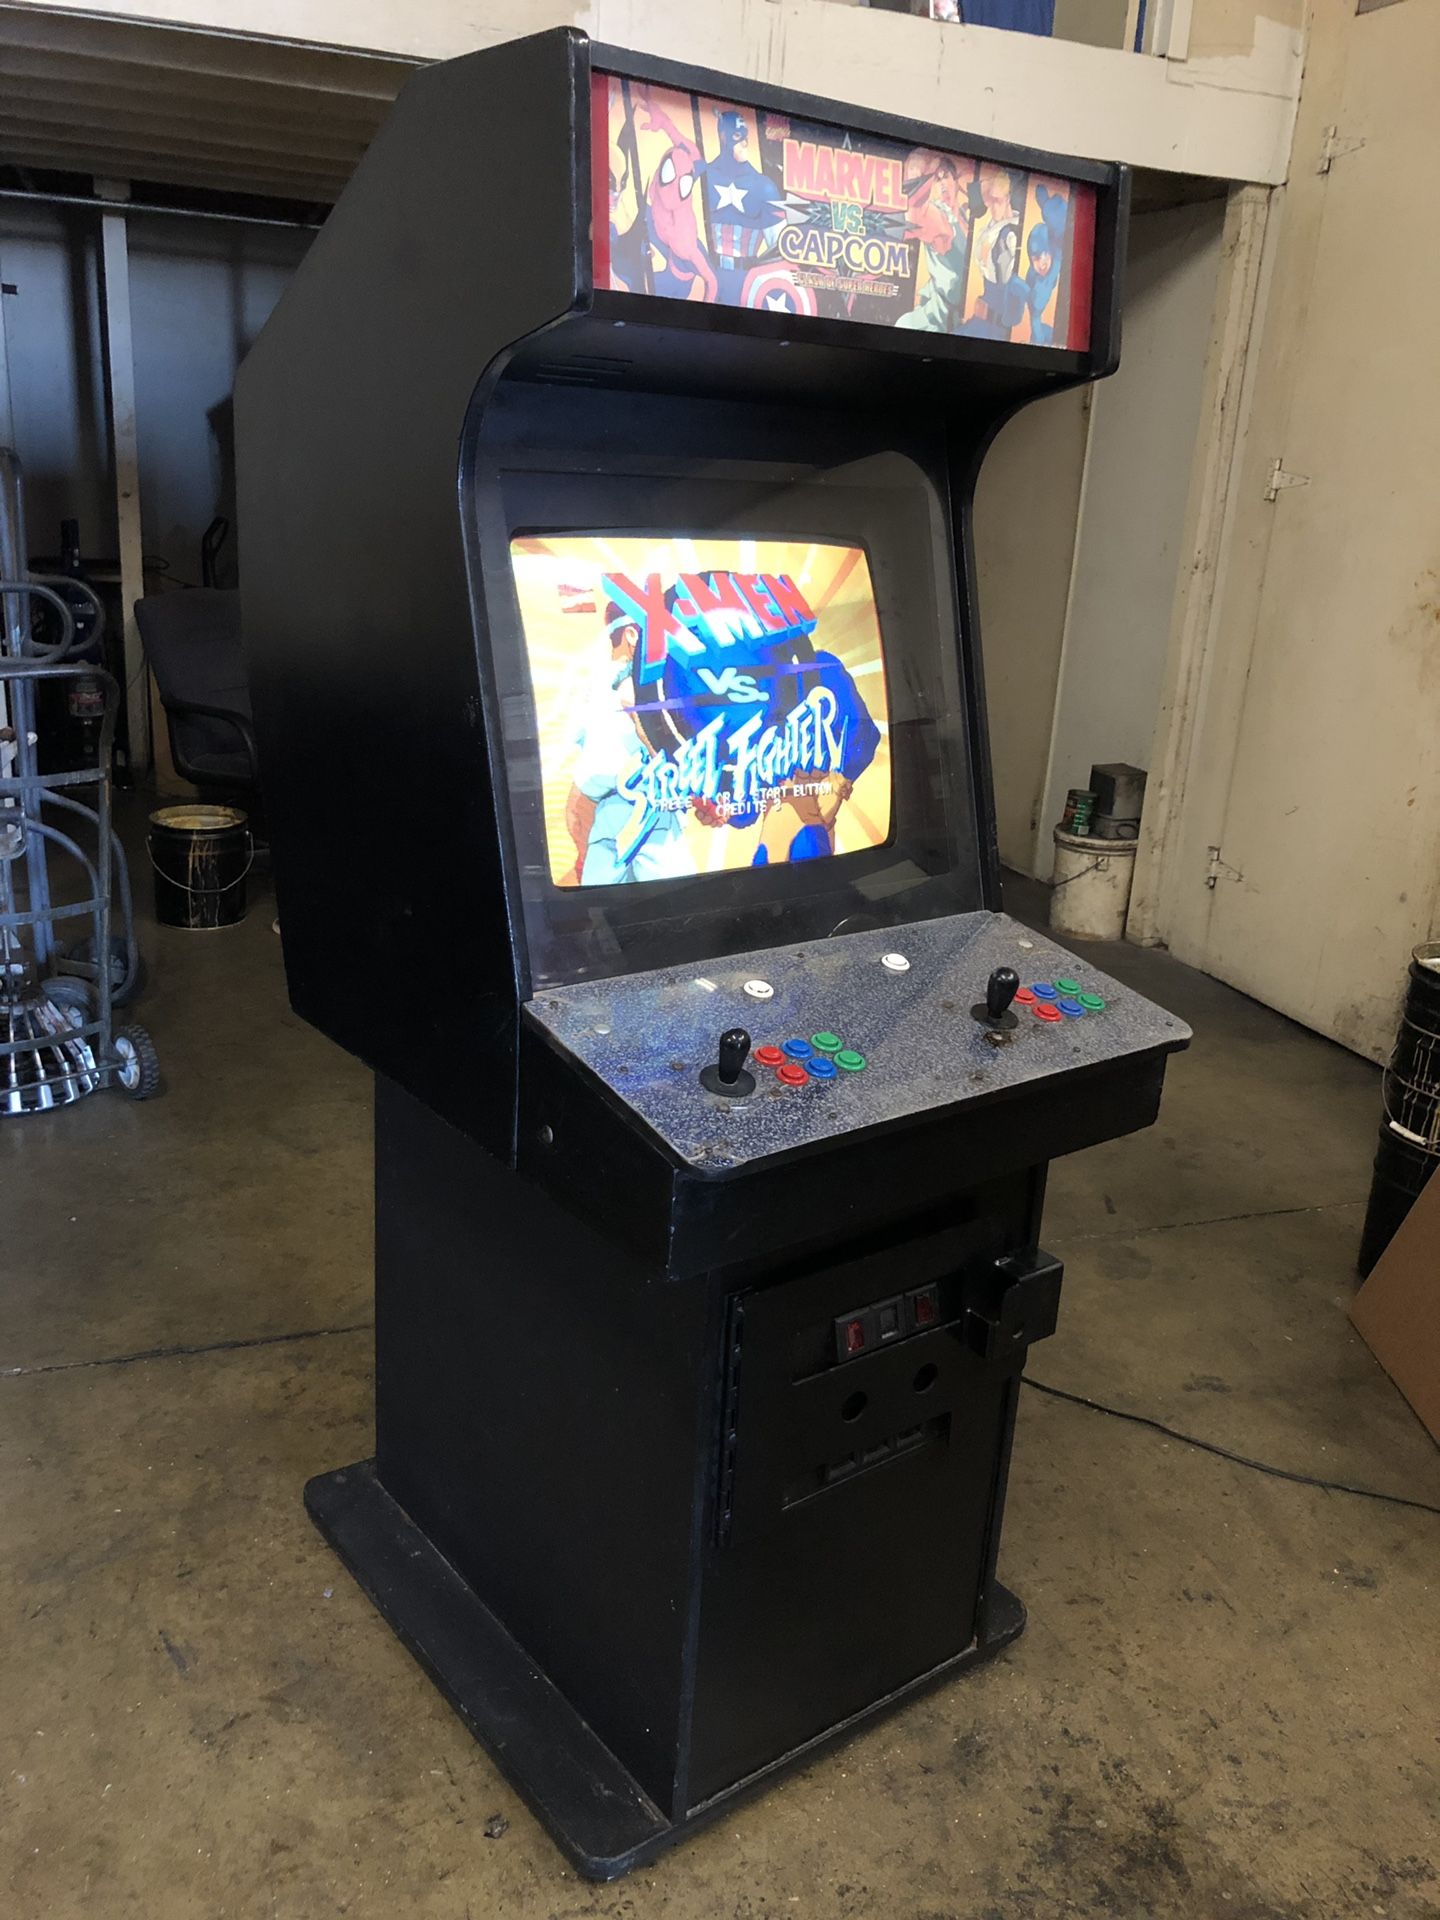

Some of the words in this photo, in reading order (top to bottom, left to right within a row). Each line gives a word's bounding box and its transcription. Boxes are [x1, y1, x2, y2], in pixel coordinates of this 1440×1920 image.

[783, 138, 908, 212] MARVEL
[830, 199, 866, 236] VS.
[779, 226, 911, 278] CAPCOM
[601, 572, 817, 685] X-MEN
[697, 667, 770, 703] VS.
[615, 712, 727, 867] STREET
[722, 685, 849, 797] FIGHTER
